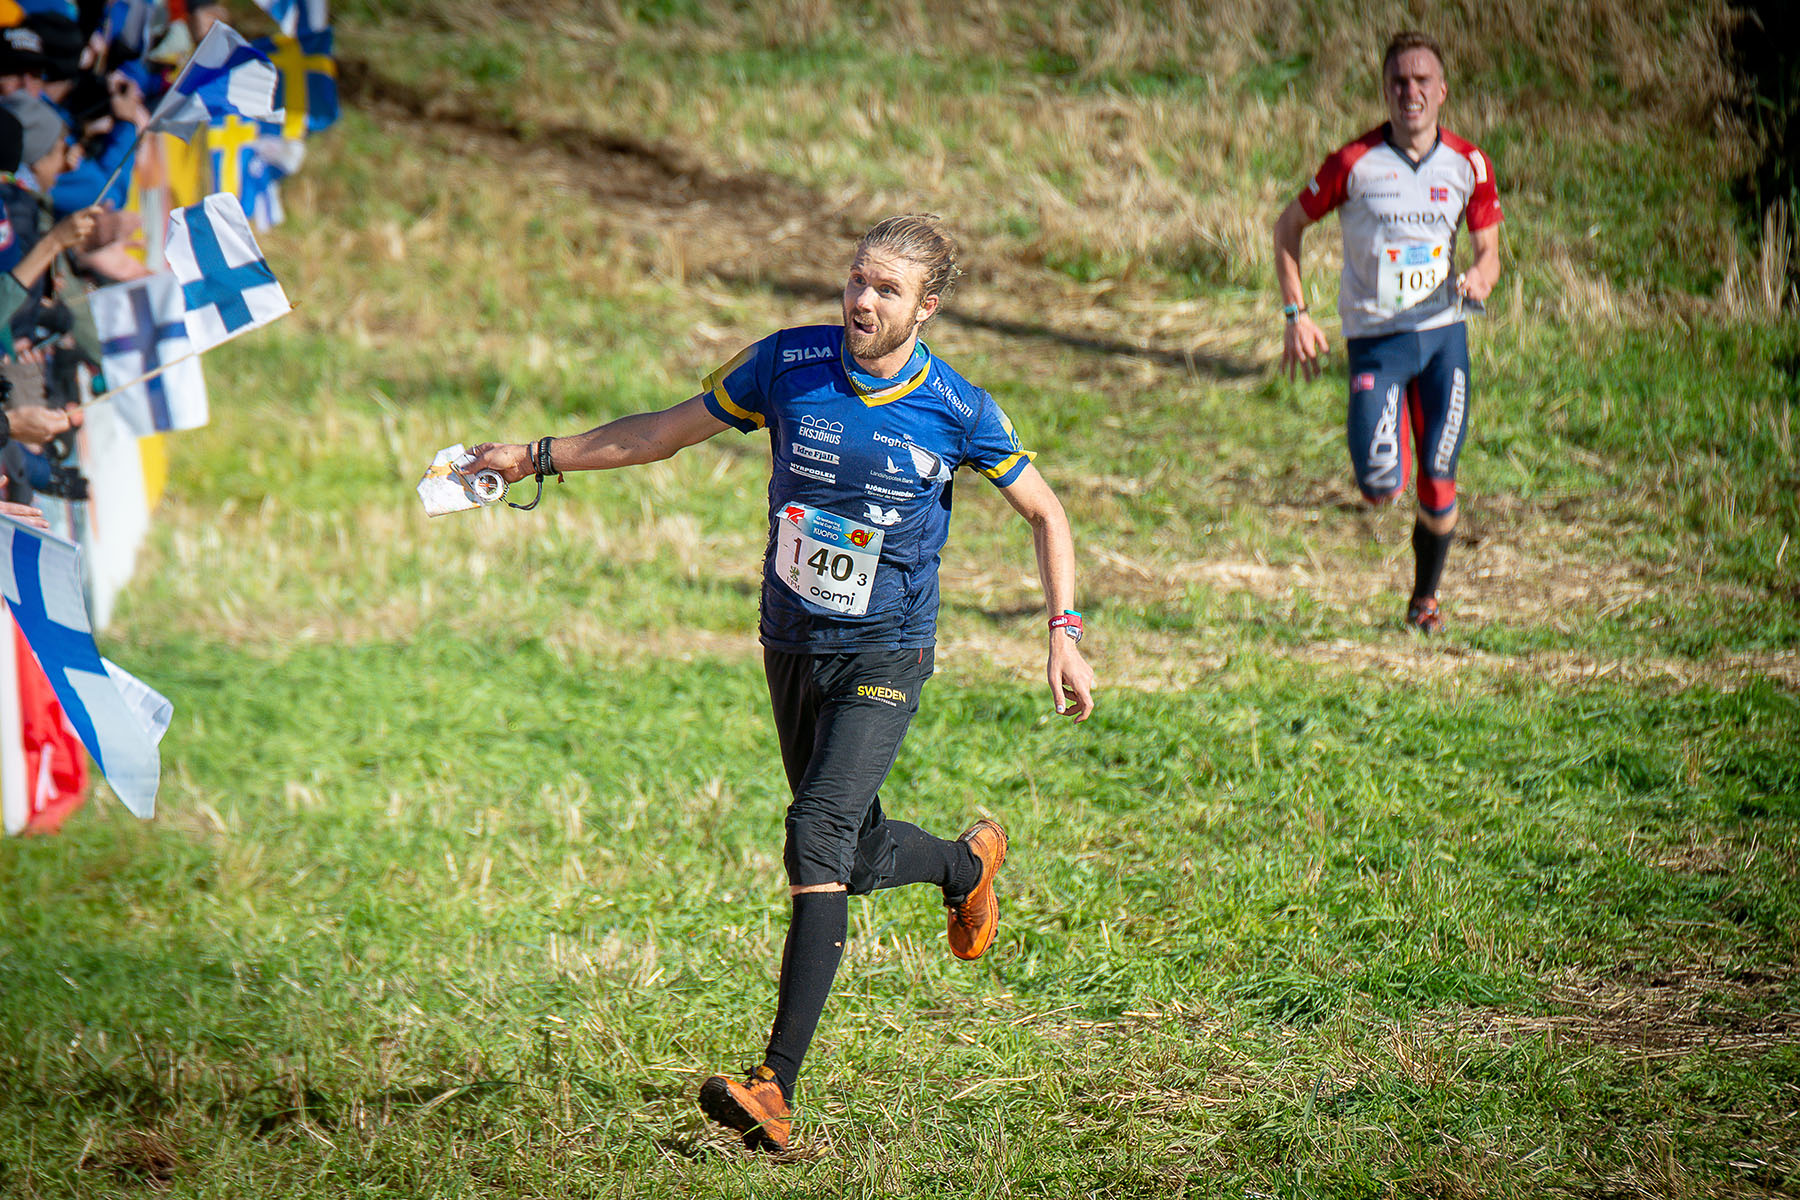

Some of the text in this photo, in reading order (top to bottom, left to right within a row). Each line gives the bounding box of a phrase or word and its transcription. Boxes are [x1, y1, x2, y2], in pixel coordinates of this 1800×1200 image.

[1394, 268, 1436, 291] 103
[783, 346, 834, 363] SILVA
[932, 376, 974, 418] Folksam
[798, 425, 842, 446] EKSJÖHUS
[797, 445, 813, 457] Idre
[865, 483, 887, 495] BJÖRN
[902, 477, 914, 485] Bank
[856, 573, 868, 587] 3
[809, 586, 856, 606] oomi
[857, 685, 906, 703] SWEDEN
